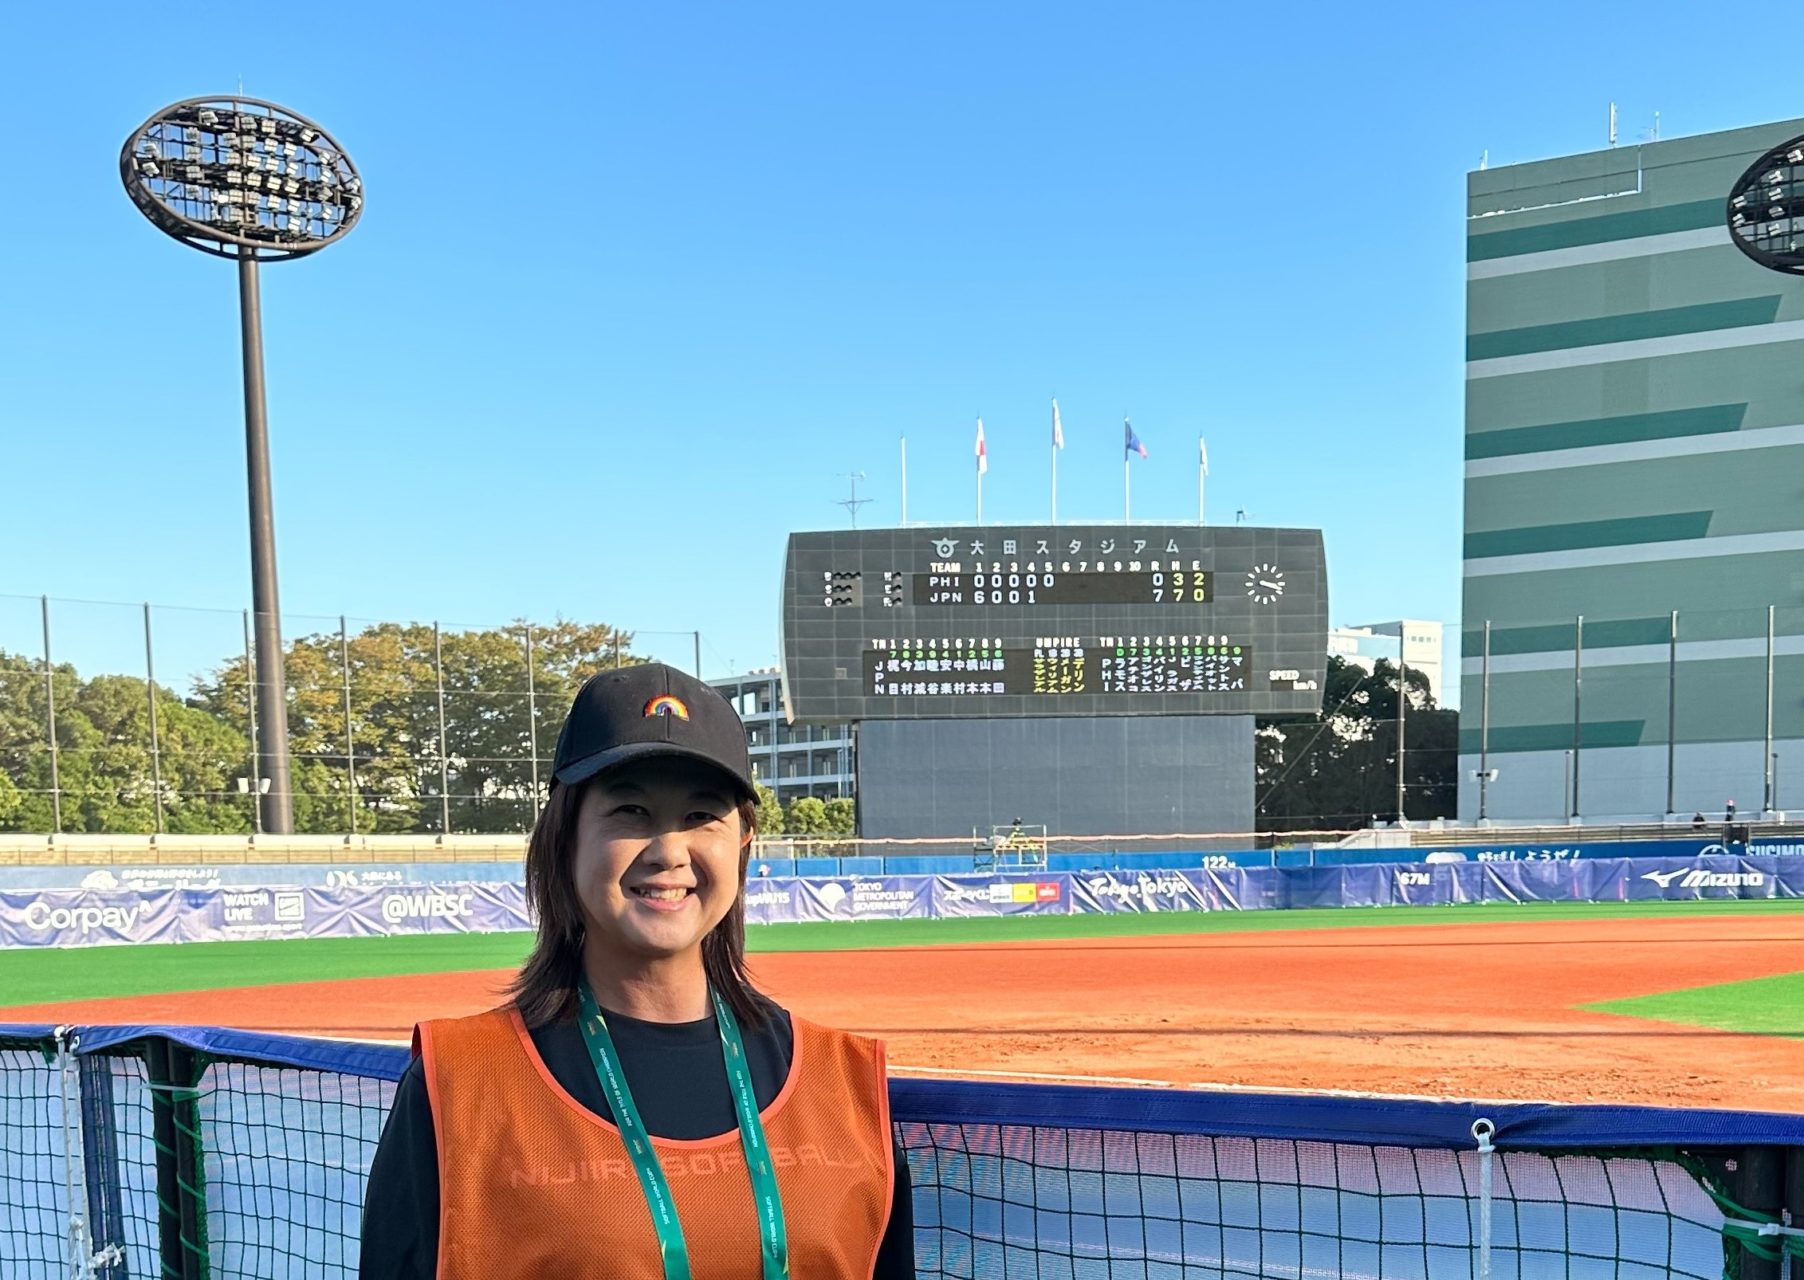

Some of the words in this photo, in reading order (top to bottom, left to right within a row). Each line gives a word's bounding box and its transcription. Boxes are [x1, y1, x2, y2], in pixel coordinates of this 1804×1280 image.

[969, 539, 1180, 555] 大田スタジアム
[930, 562, 961, 573] TEAM
[976, 562, 983, 572] 1
[992, 562, 1001, 572] 2
[1010, 562, 1019, 572] 3
[1027, 562, 1036, 572] 4
[1044, 562, 1053, 572] 5
[1062, 562, 1071, 572] 6
[1079, 562, 1087, 572] 7
[1096, 562, 1105, 572] 8
[1114, 562, 1122, 572] 9
[1129, 562, 1142, 572] 10
[1151, 561, 1160, 571] R
[1172, 561, 1181, 571] H
[1192, 560, 1200, 570] E
[930, 576, 960, 587] PHI
[973, 574, 985, 588] 0
[991, 574, 1002, 588] 0
[1008, 574, 1020, 588] 0
[1026, 574, 1037, 588] 0
[1043, 574, 1055, 588] 0
[1152, 573, 1163, 586] 0
[1173, 573, 1184, 586] 3
[1193, 573, 1205, 586] 2
[930, 592, 962, 603] JPN
[974, 591, 985, 604] 6
[991, 591, 1002, 604] 0
[1008, 591, 1020, 604] 0
[1028, 590, 1036, 603] 1
[1153, 589, 1163, 602] 7
[1173, 589, 1184, 602] 7
[1193, 588, 1205, 601] 0
[890, 638, 896, 649] 1
[903, 638, 910, 649] 2
[916, 638, 923, 649] 3
[929, 638, 936, 649] 4
[942, 638, 949, 649] 5
[955, 638, 963, 649] 6
[968, 638, 976, 649] 7
[981, 638, 989, 649] 8
[994, 638, 1002, 649] 9
[1036, 637, 1080, 648] UMPIRE
[1117, 636, 1123, 646] 1
[1130, 636, 1137, 646] 2
[1143, 636, 1150, 646] 3
[1155, 636, 1163, 646] 4
[1168, 636, 1176, 646] 5
[1181, 636, 1189, 646] 6
[1194, 636, 1202, 646] 7
[1207, 636, 1215, 646] 8
[1220, 636, 1228, 646] 9
[889, 650, 897, 659] 7
[942, 650, 949, 659] 4
[956, 650, 962, 659] 1
[968, 650, 976, 659] 2
[1129, 648, 1137, 656] 7
[1143, 648, 1150, 656] 3
[1155, 648, 1163, 656] 4
[1169, 648, 1175, 656] 1
[1181, 647, 1190, 655] 2
[874, 661, 885, 695] JPN
[1101, 658, 1112, 692] PHI
[1115, 658, 1126, 692] ラモス
[223, 893, 269, 907] WATCH
[224, 907, 253, 921] LIVE
[382, 893, 473, 924] @WBSC
[511, 1159, 628, 1188] NIJIIR
[664, 1144, 860, 1178] SOFBALL
